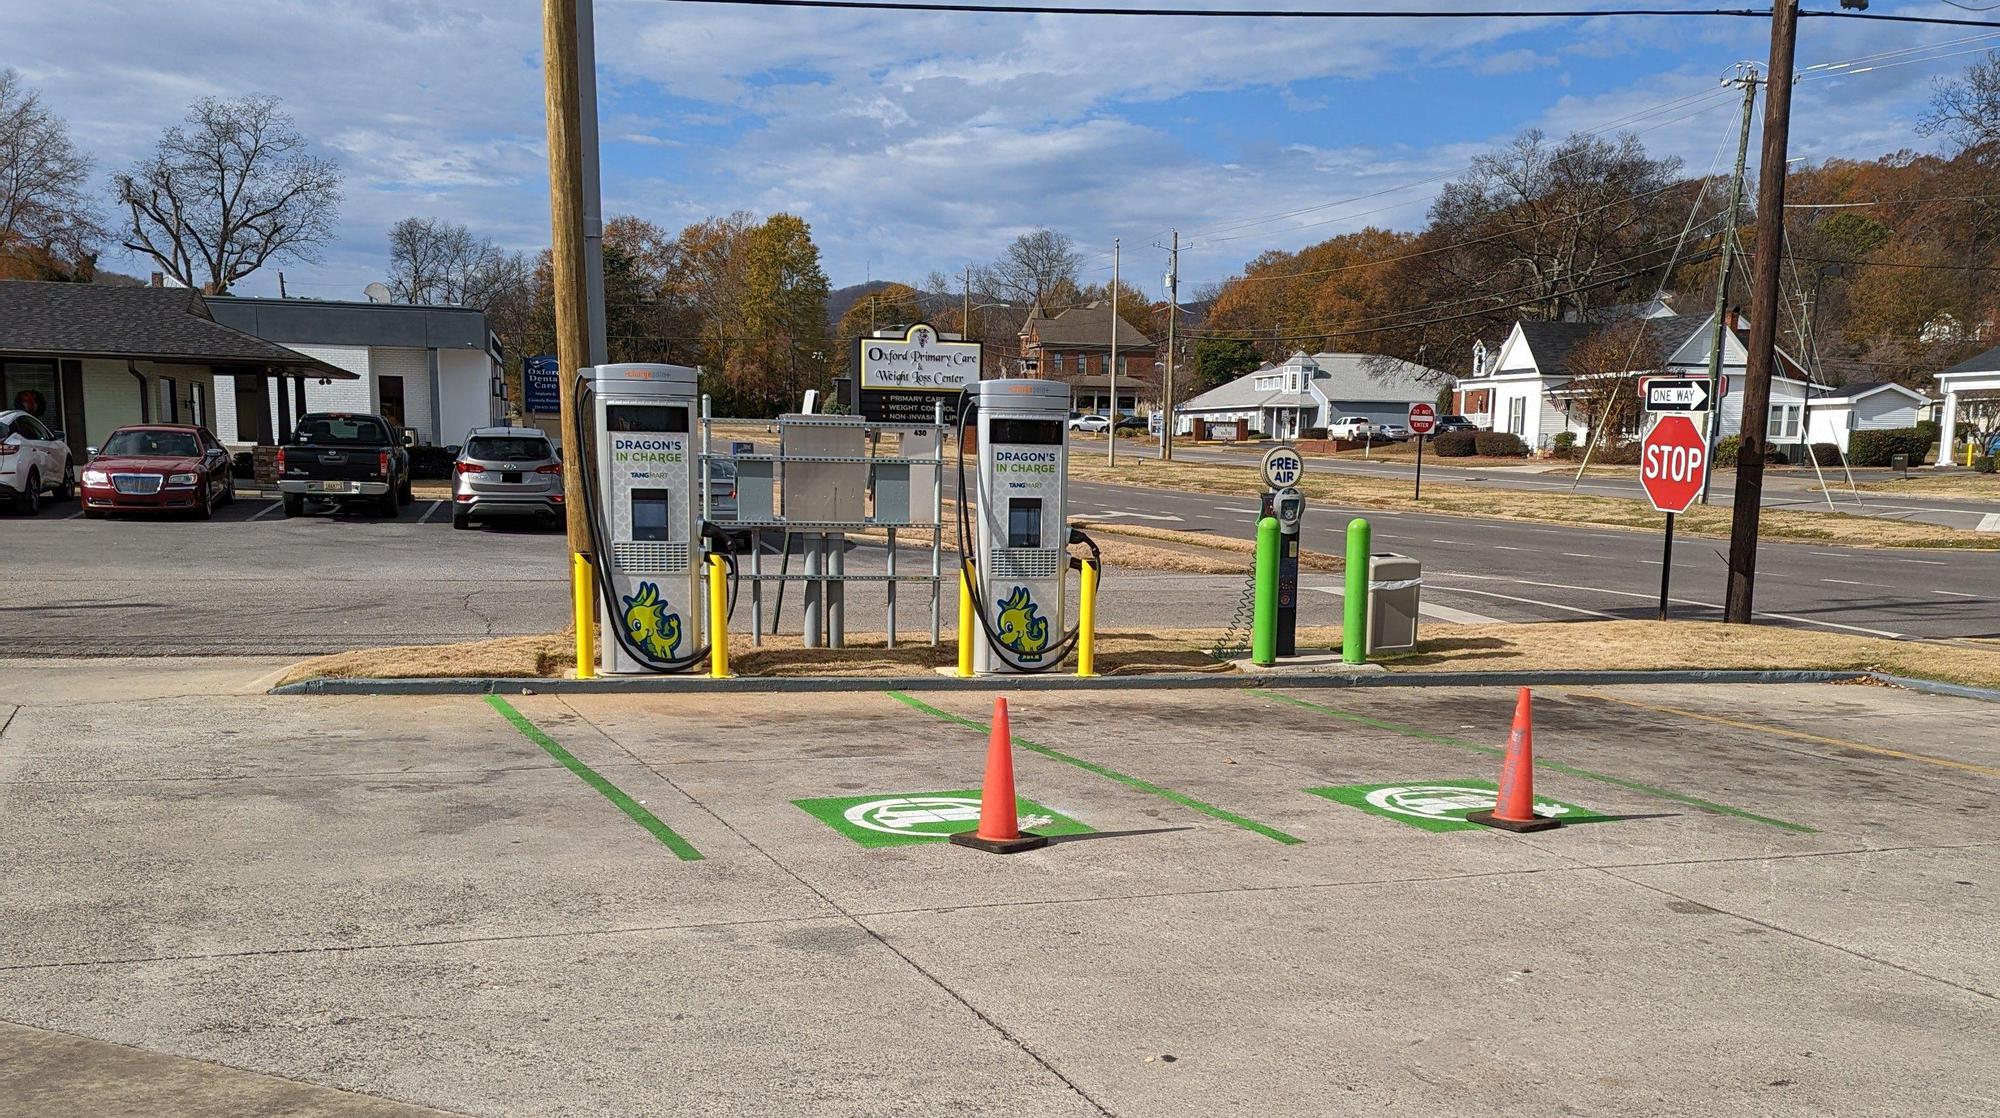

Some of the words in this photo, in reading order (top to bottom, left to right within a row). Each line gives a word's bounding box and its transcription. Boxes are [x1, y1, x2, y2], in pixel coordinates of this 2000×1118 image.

[868, 347, 908, 365] Oxford
[910, 350, 952, 367] Primary
[953, 351, 977, 366] Care
[875, 369, 909, 386] Weight
[911, 371, 932, 386] Loss
[933, 371, 965, 385] Center
[1653, 389, 1671, 402] ONE
[1676, 389, 1695, 402] WAY
[889, 413, 937, 421] NON-INVASIV
[615, 439, 682, 451] DRAGON'S
[615, 452, 628, 462] IN
[632, 452, 682, 464] CHARGE
[996, 452, 1056, 462] DRAGON'S
[1645, 443, 1702, 483] STOP
[996, 463, 1007, 473] IN
[1010, 463, 1056, 474] CHARGE
[1269, 457, 1299, 471] FREE
[1274, 470, 1295, 483] AIR
